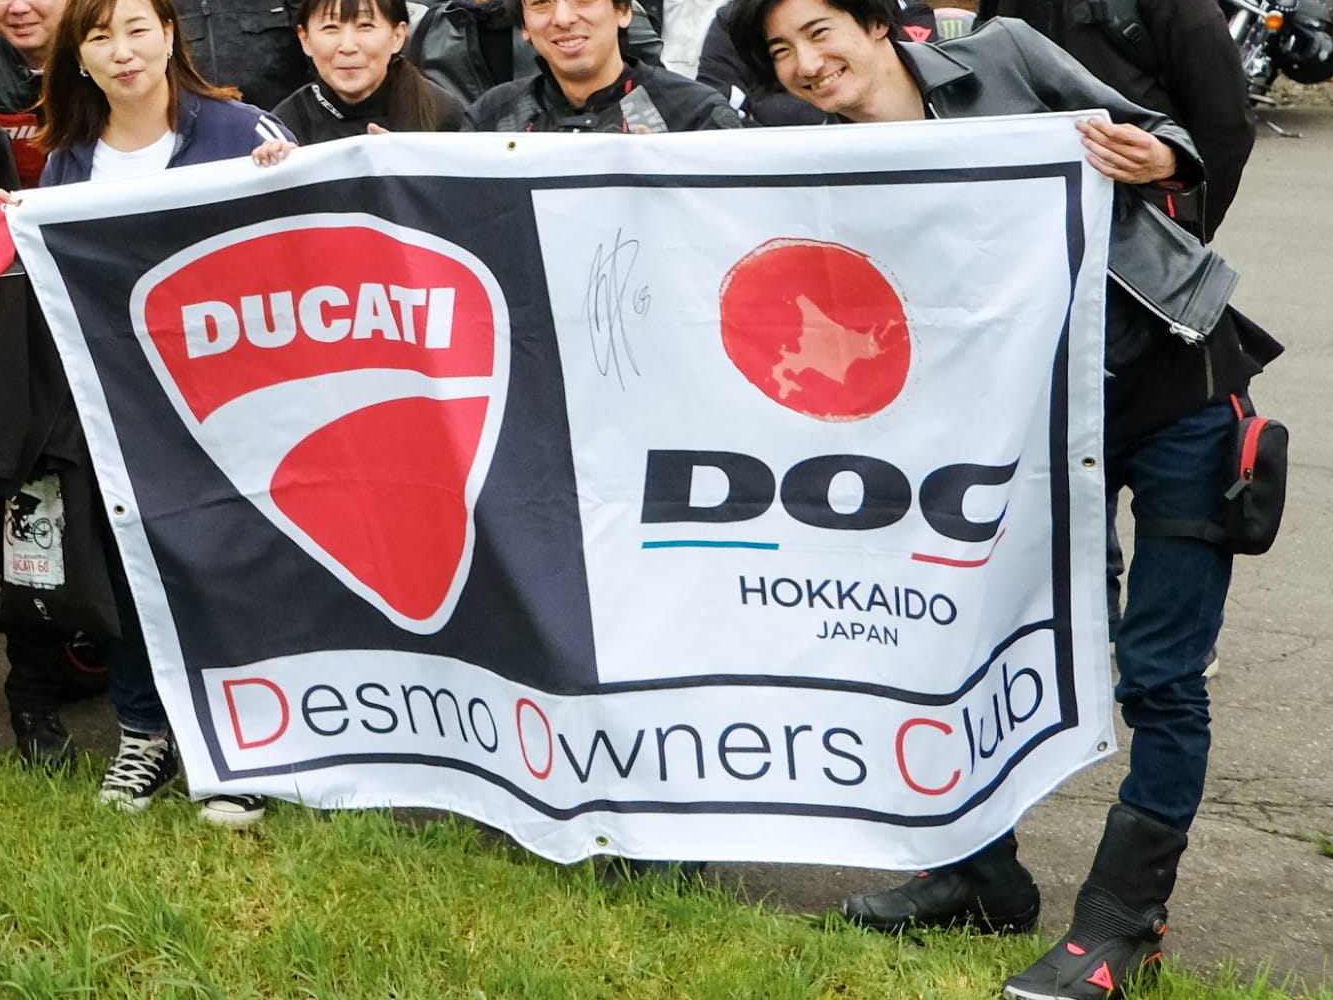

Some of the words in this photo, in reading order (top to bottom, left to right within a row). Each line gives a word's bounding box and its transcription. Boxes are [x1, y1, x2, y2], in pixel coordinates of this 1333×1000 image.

[182, 283, 456, 359] DUCATI
[640, 449, 1020, 543] DOC
[739, 575, 958, 625] HOKKAIDO
[817, 620, 899, 647] JAPAN
[222, 676, 499, 754] Desmo
[516, 698, 868, 787] Owners
[895, 662, 1043, 796] Club
